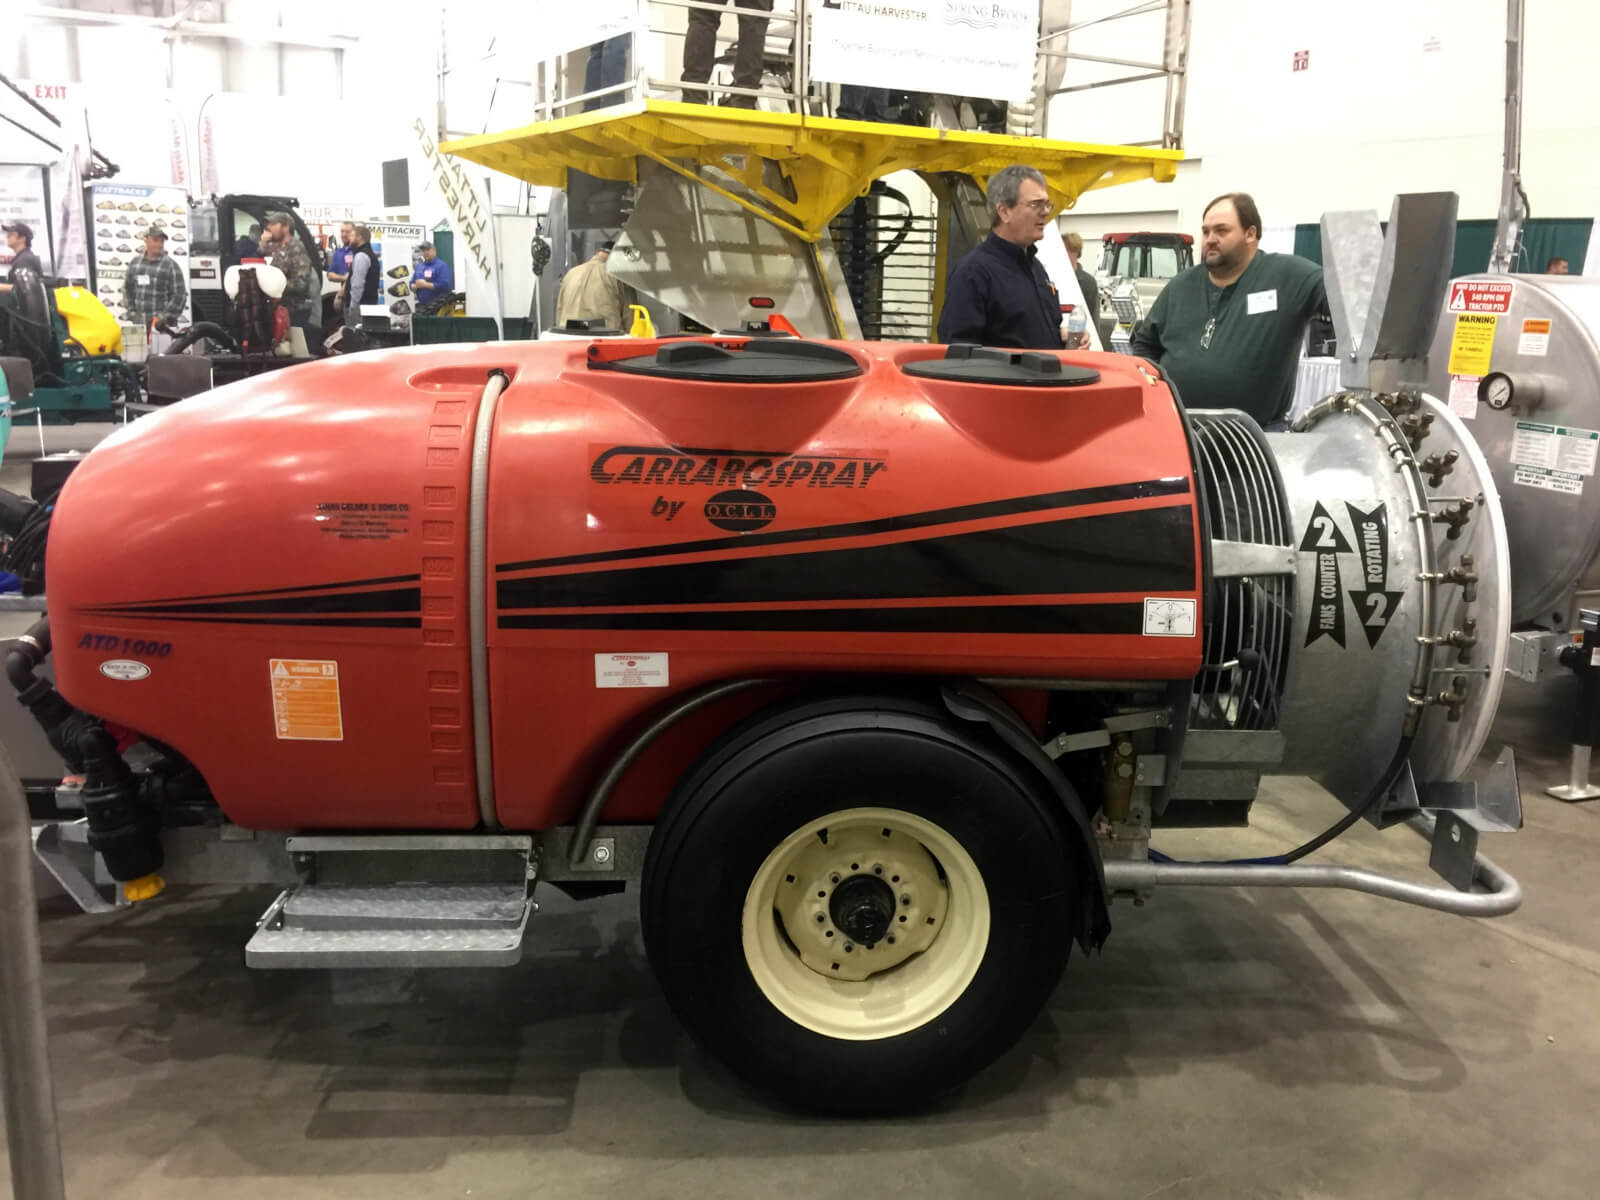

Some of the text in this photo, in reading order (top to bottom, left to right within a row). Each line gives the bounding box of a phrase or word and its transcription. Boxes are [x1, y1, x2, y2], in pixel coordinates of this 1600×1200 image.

[874, 6, 928, 21] HARVESTER
[35, 85, 67, 99] EXIT
[367, 225, 421, 235] MATTRACKS
[1459, 314, 1496, 325] WARNING
[590, 446, 885, 488] CARRAROSPRAY
[651, 496, 684, 520] by
[1313, 516, 1336, 547] 2
[1362, 521, 1383, 583] ROTATING
[1319, 553, 1336, 630] FANS COUNTER
[1364, 592, 1388, 626] 2
[121, 638, 173, 656] 1000
